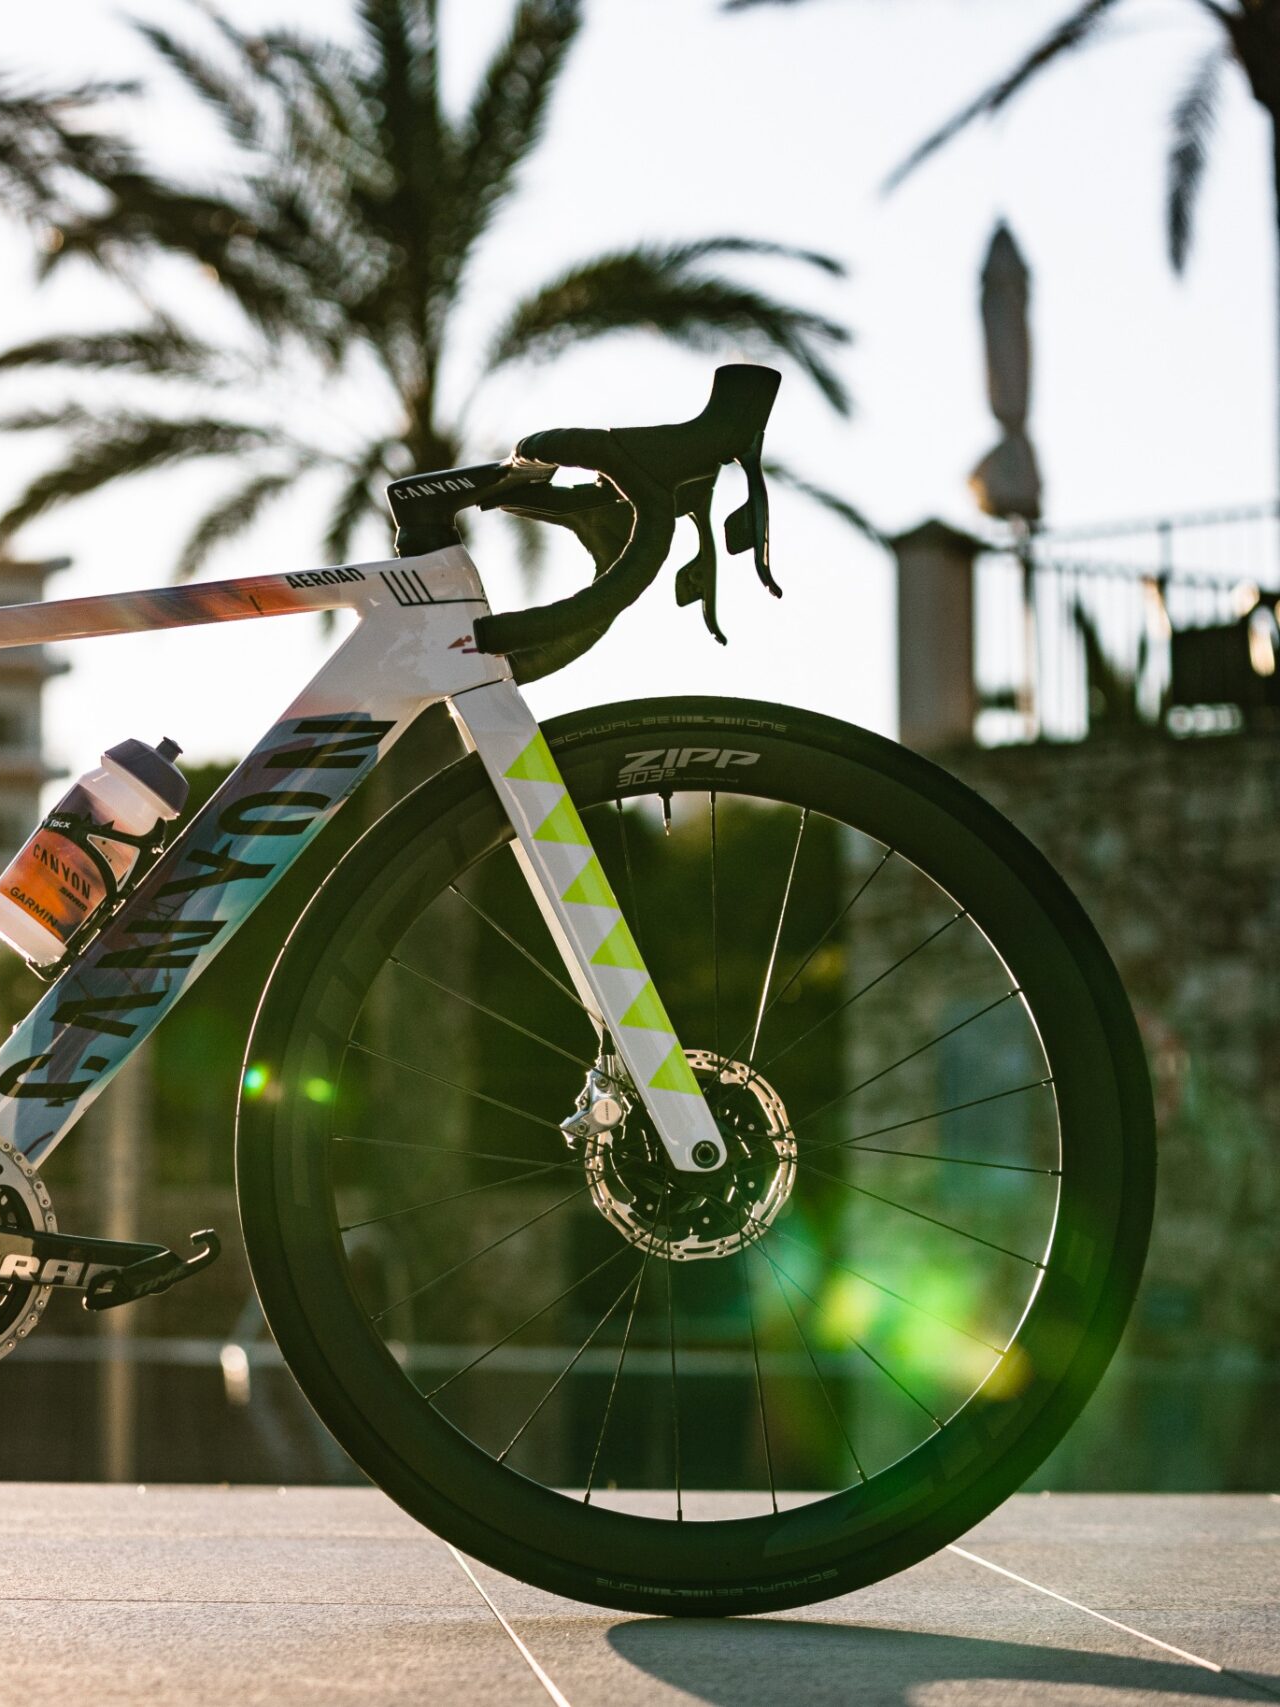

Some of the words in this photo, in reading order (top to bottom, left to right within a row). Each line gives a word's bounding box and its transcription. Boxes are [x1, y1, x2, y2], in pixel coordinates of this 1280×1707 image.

[393, 477, 476, 500] CANYON
[284, 567, 366, 590] AEROAD
[549, 715, 674, 746] SCHWALBE
[746, 718, 788, 733] ONE
[618, 747, 761, 775] ZIPP
[49, 818, 71, 829] Tacx
[32, 843, 92, 900] CANYON
[10, 886, 59, 928] GARMIN
